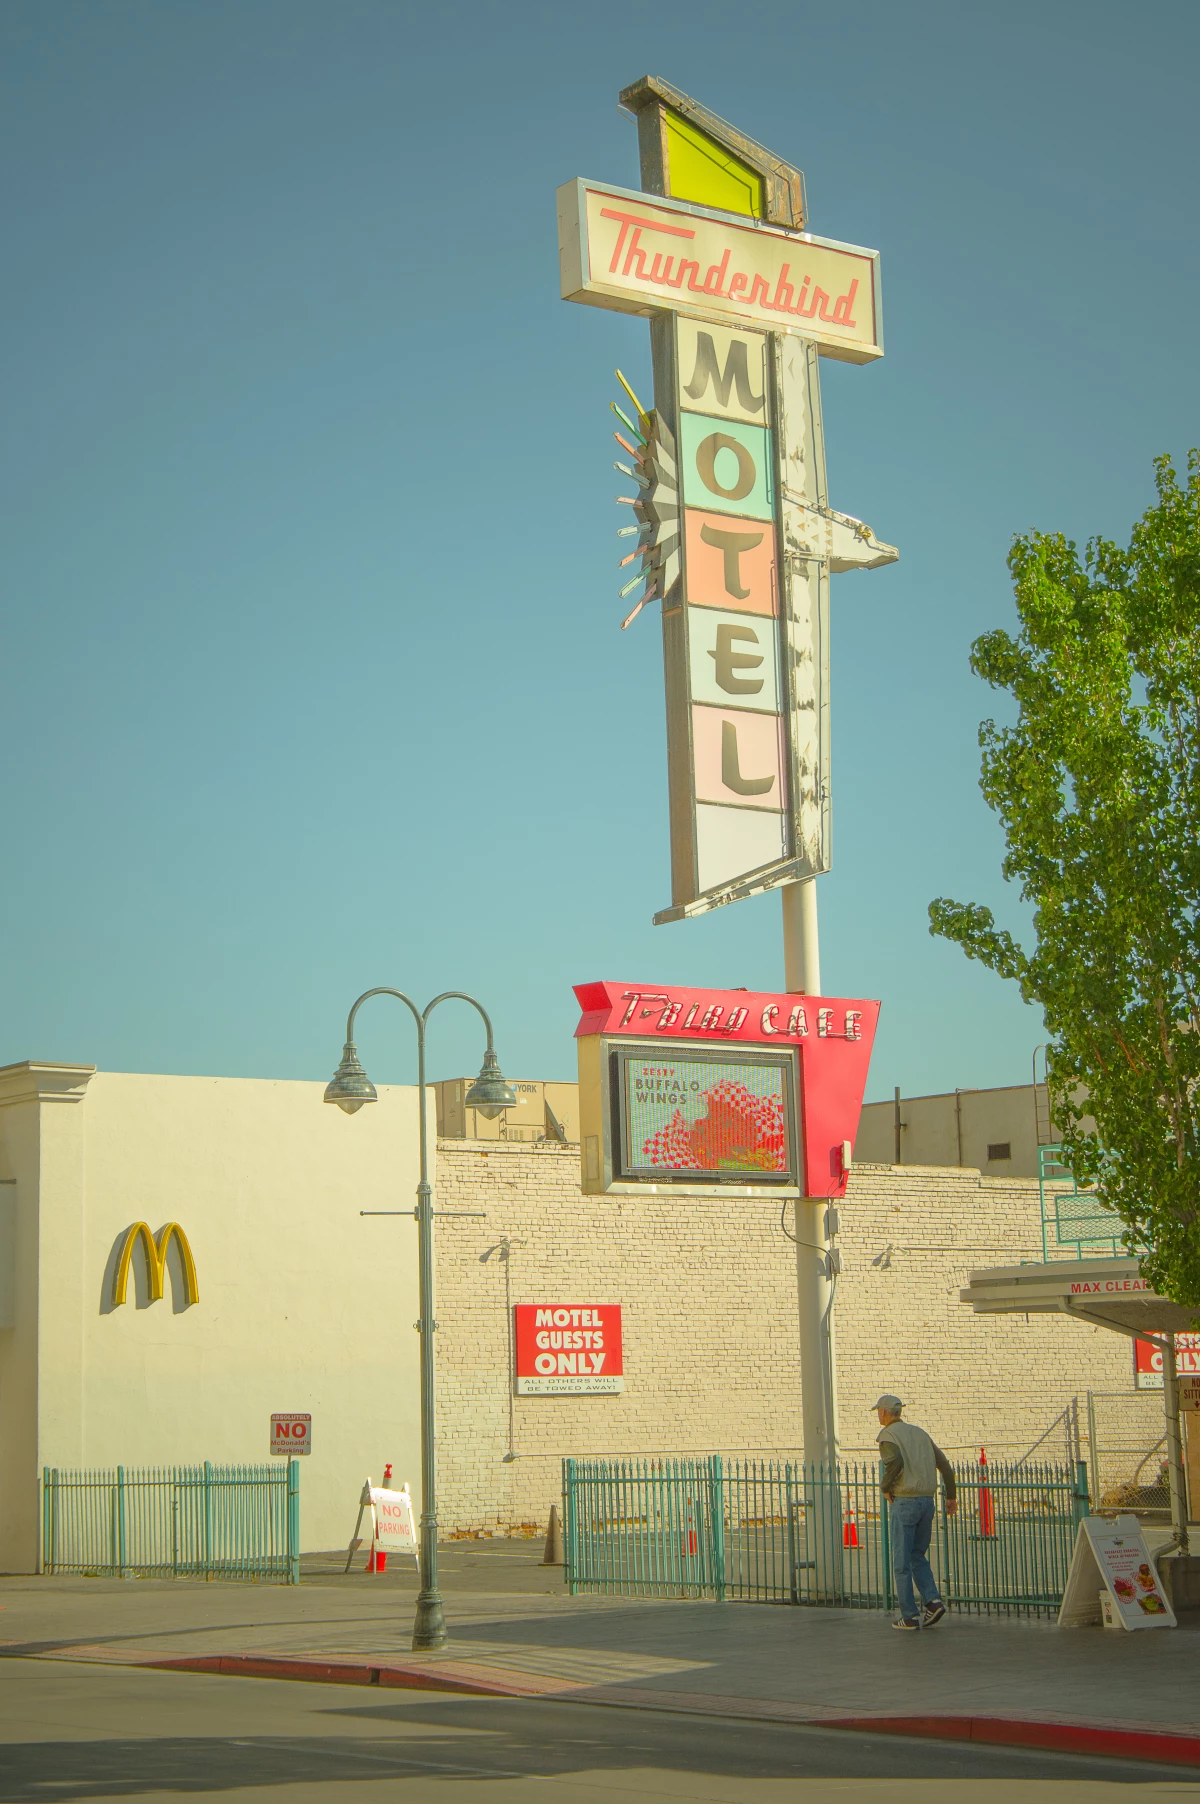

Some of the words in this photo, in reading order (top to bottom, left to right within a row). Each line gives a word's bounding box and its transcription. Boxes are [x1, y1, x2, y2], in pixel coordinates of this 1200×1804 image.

[600, 207, 860, 328] Thunderbird
[683, 331, 775, 796] MOTEL
[762, 1003, 863, 1041] CAFE
[642, 1068, 674, 1076] ZESTY
[517, 1084, 537, 1093] YORK
[635, 1079, 699, 1091] BUFFALO
[635, 1092, 686, 1104] WINGS
[1071, 1282, 1101, 1294] MAX
[535, 1309, 603, 1327] MOTEL
[535, 1331, 604, 1349] GUESTS
[534, 1353, 607, 1375] ONLY
[275, 1423, 307, 1438] NO
[382, 1505, 402, 1518] NO
[379, 1521, 410, 1536] PARKING
